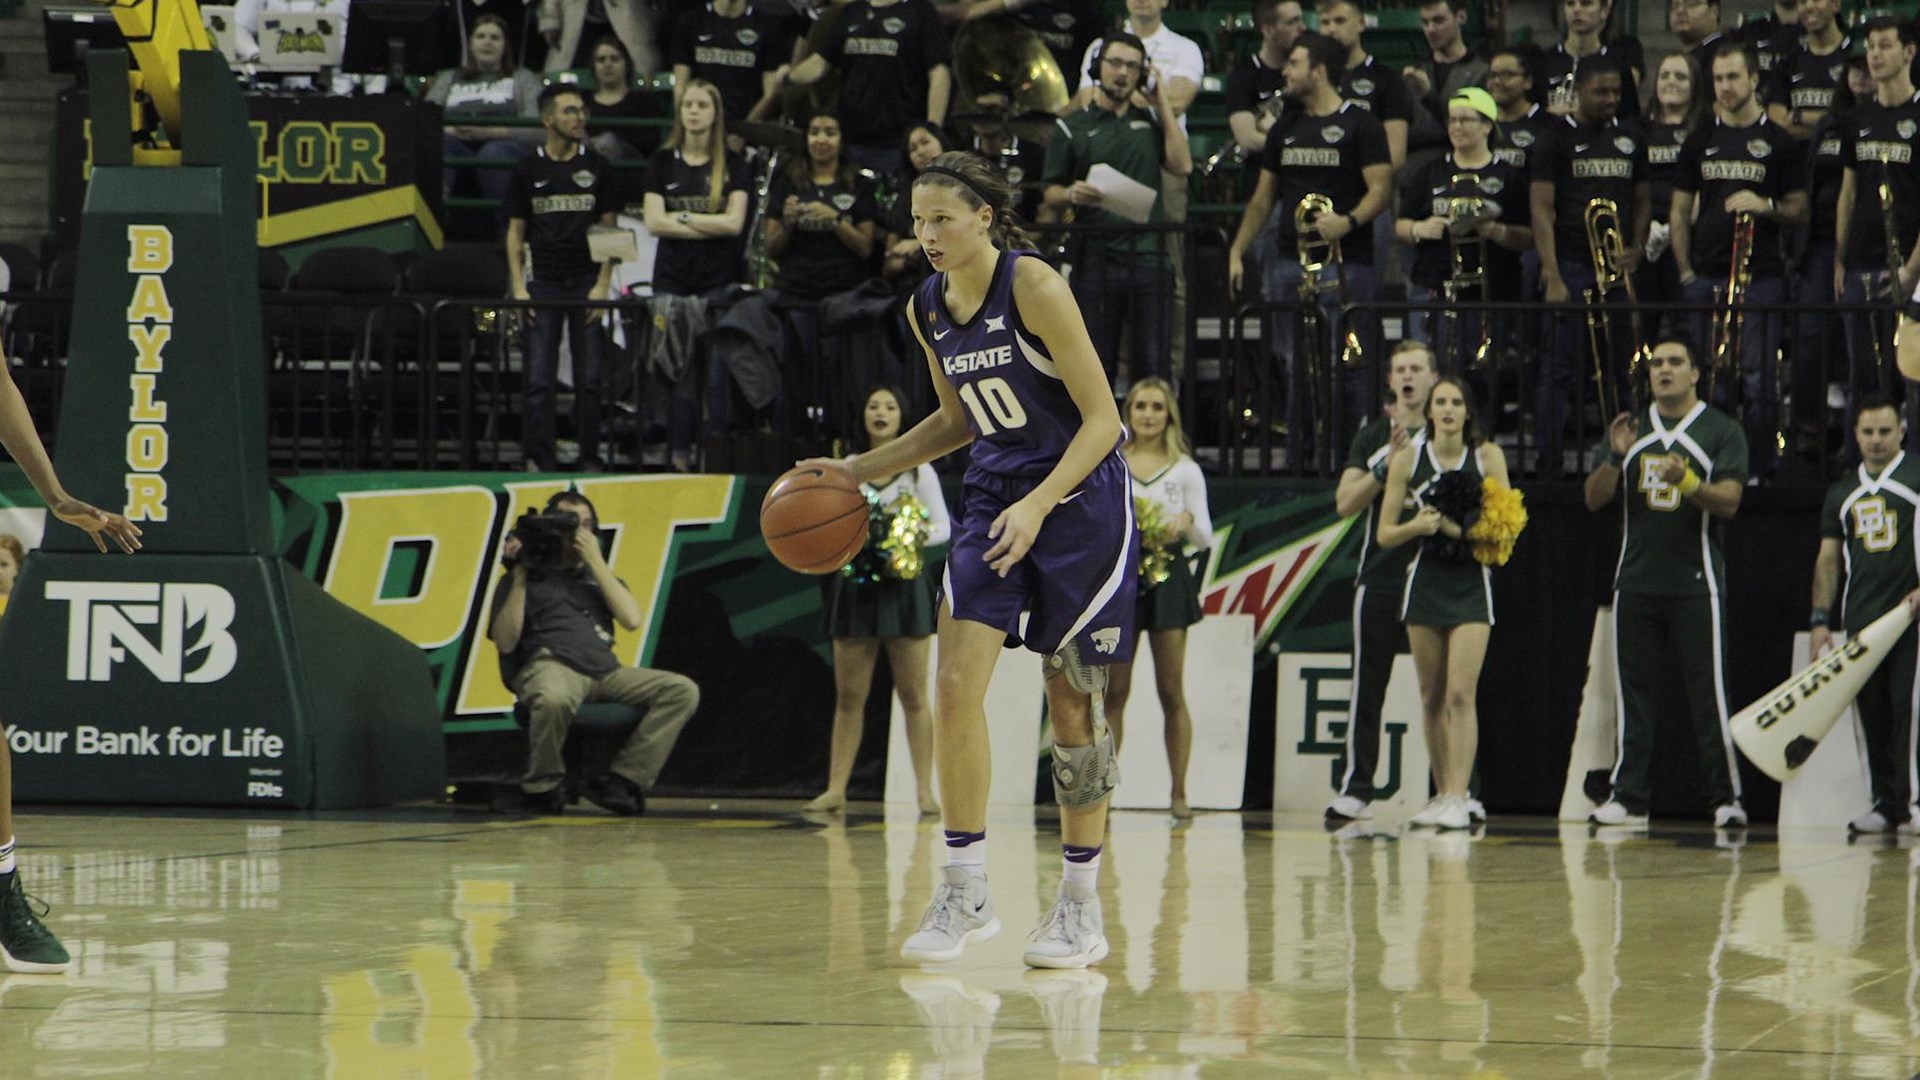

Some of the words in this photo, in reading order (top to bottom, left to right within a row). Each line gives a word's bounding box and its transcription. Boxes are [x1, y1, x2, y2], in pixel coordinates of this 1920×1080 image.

[1701, 160, 1766, 184] BAYLOR
[123, 224, 173, 522] BAYLOR
[943, 344, 1013, 376] K-STATE
[958, 376, 1028, 437] 10
[1851, 496, 1899, 554] BU
[75, 725, 161, 756] Bank
[167, 726, 217, 757] for
[222, 727, 284, 758] Life
